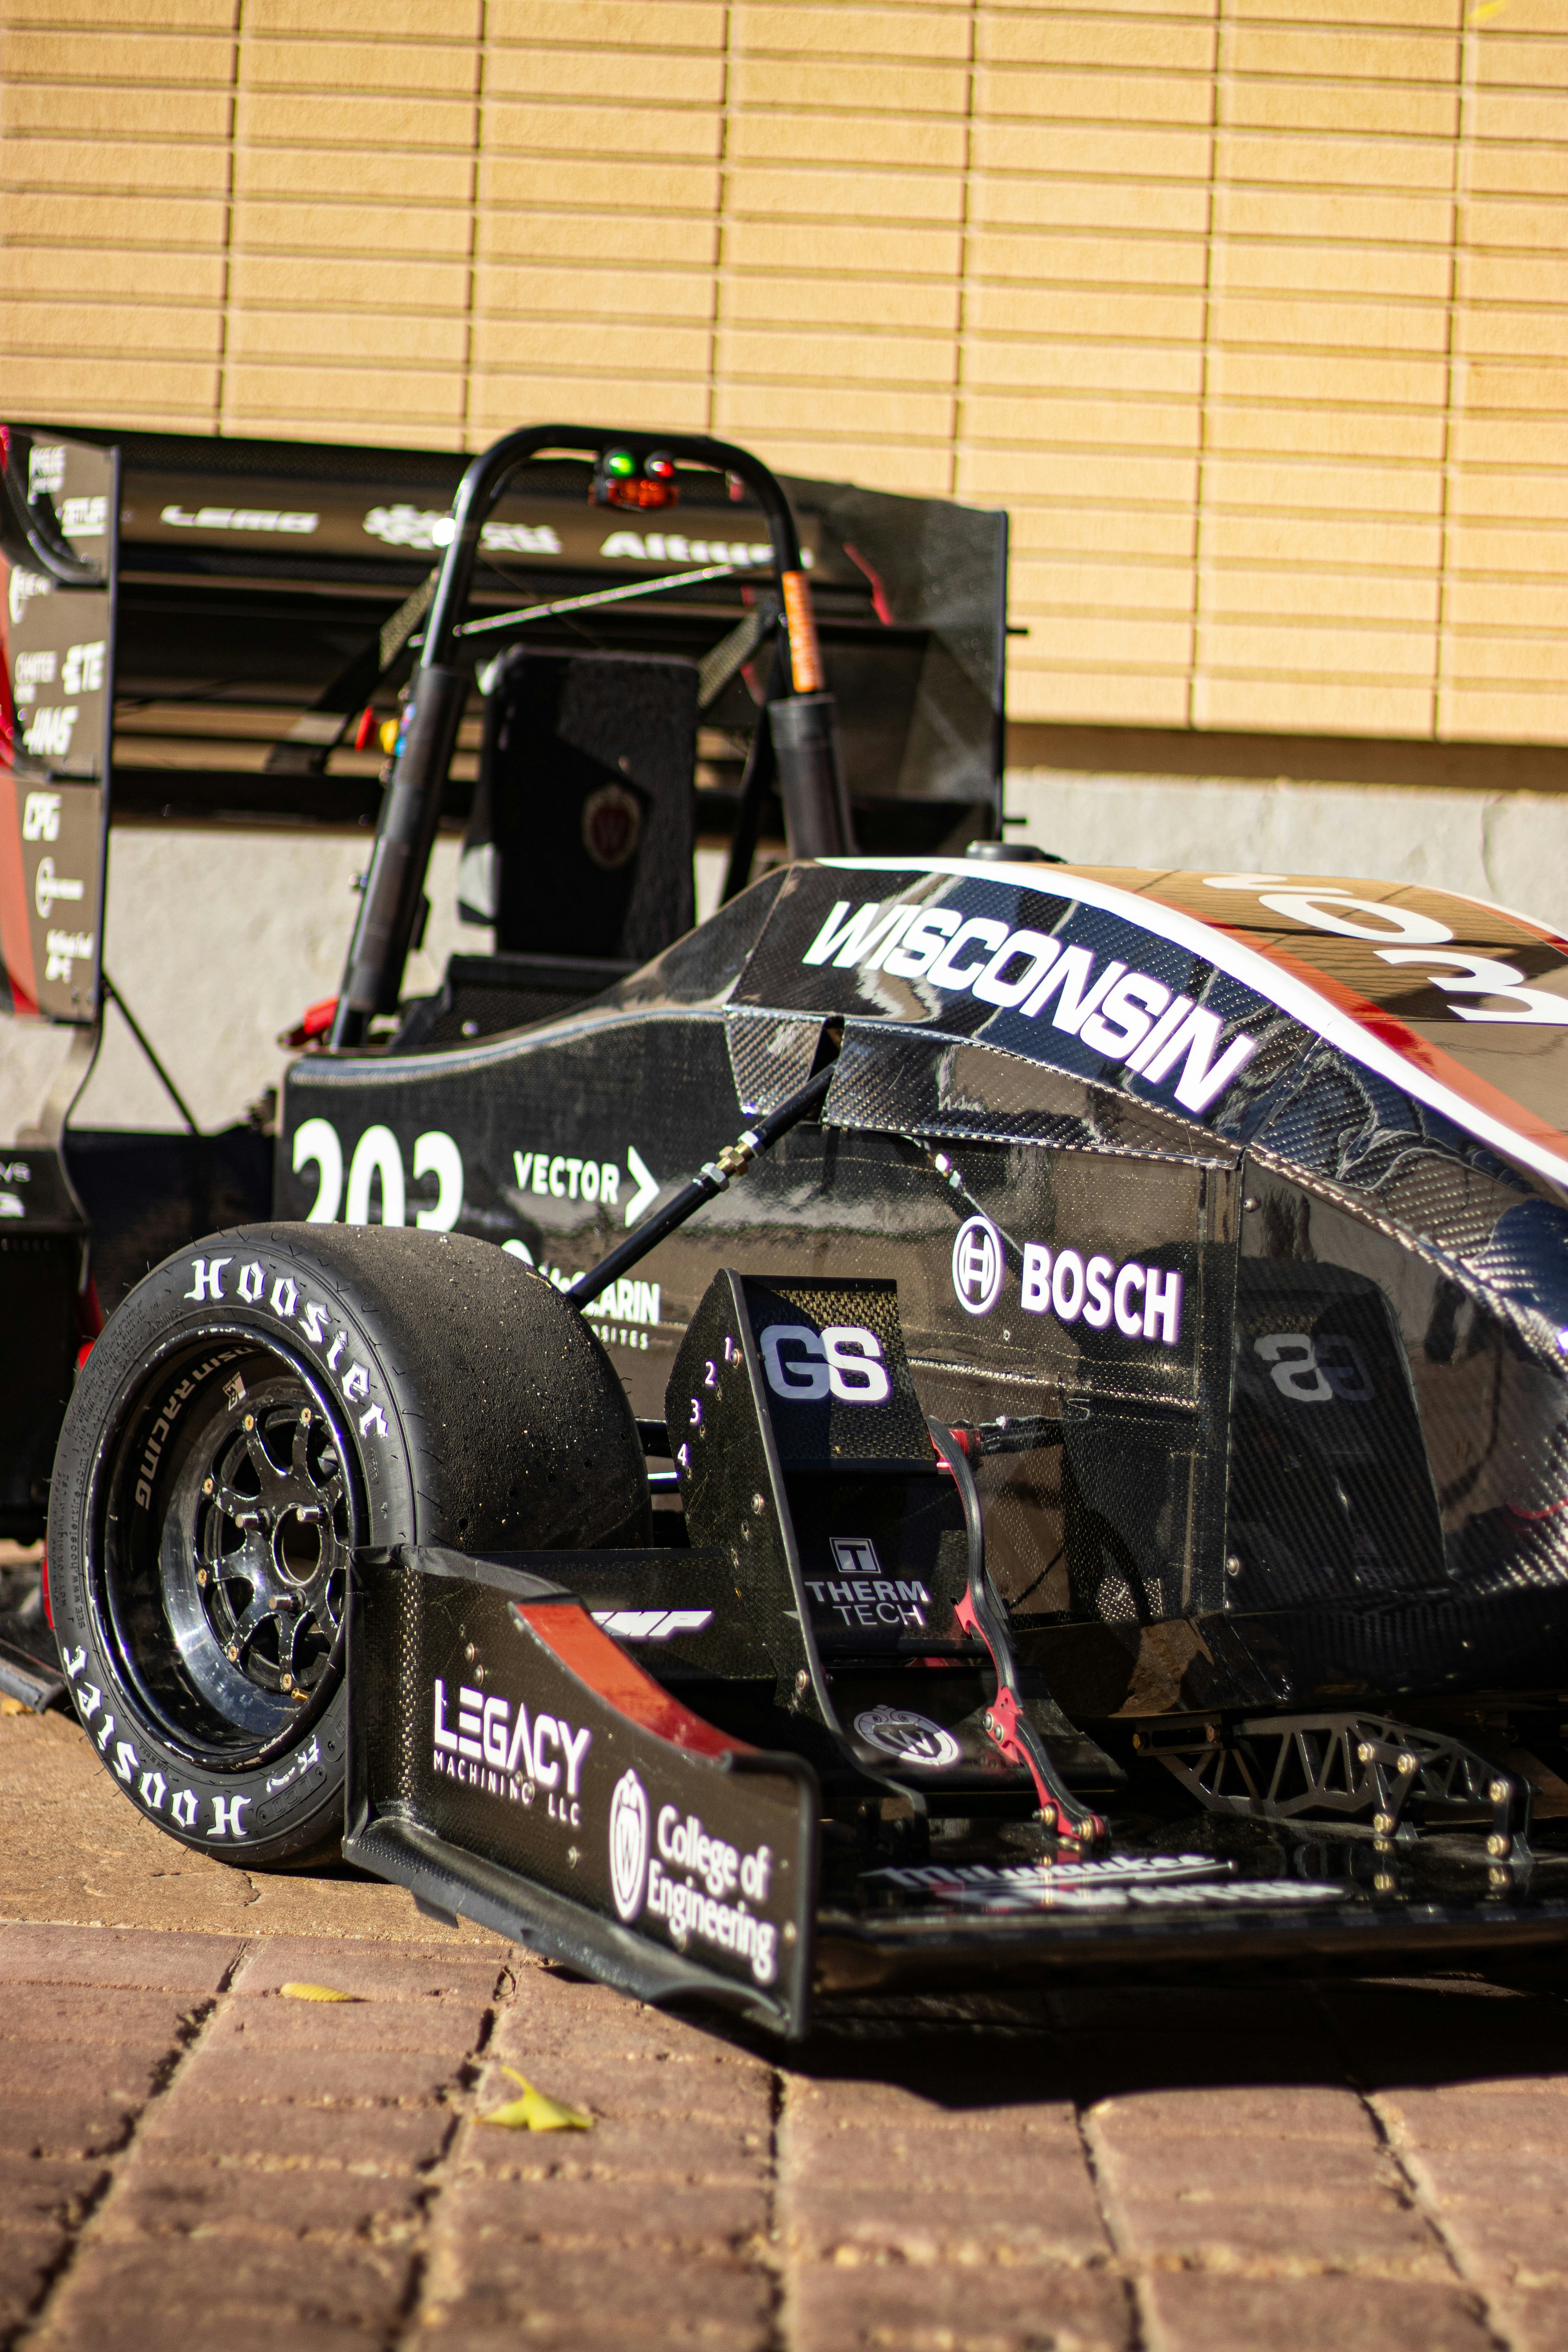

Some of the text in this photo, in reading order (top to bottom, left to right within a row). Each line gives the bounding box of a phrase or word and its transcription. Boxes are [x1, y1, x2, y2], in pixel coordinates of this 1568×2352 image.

[802, 901, 1255, 1112] WISCONSIN
[513, 1150, 620, 1204] VECTOR
[1021, 1243, 1178, 1343] BOSCH
[704, 1361, 715, 1385] 2
[724, 1337, 732, 1360] 1
[760, 1325, 889, 1401] GS
[690, 1399, 699, 1423] 3
[677, 1443, 688, 1466] 4
[804, 1581, 929, 1601] THERM
[833, 1602, 923, 1626] TECH
[434, 1679, 590, 1794] LEGACY
[434, 1749, 580, 1826] MACHINING LLC
[657, 1805, 772, 1901] College of
[648, 1859, 776, 1982] Engineering
